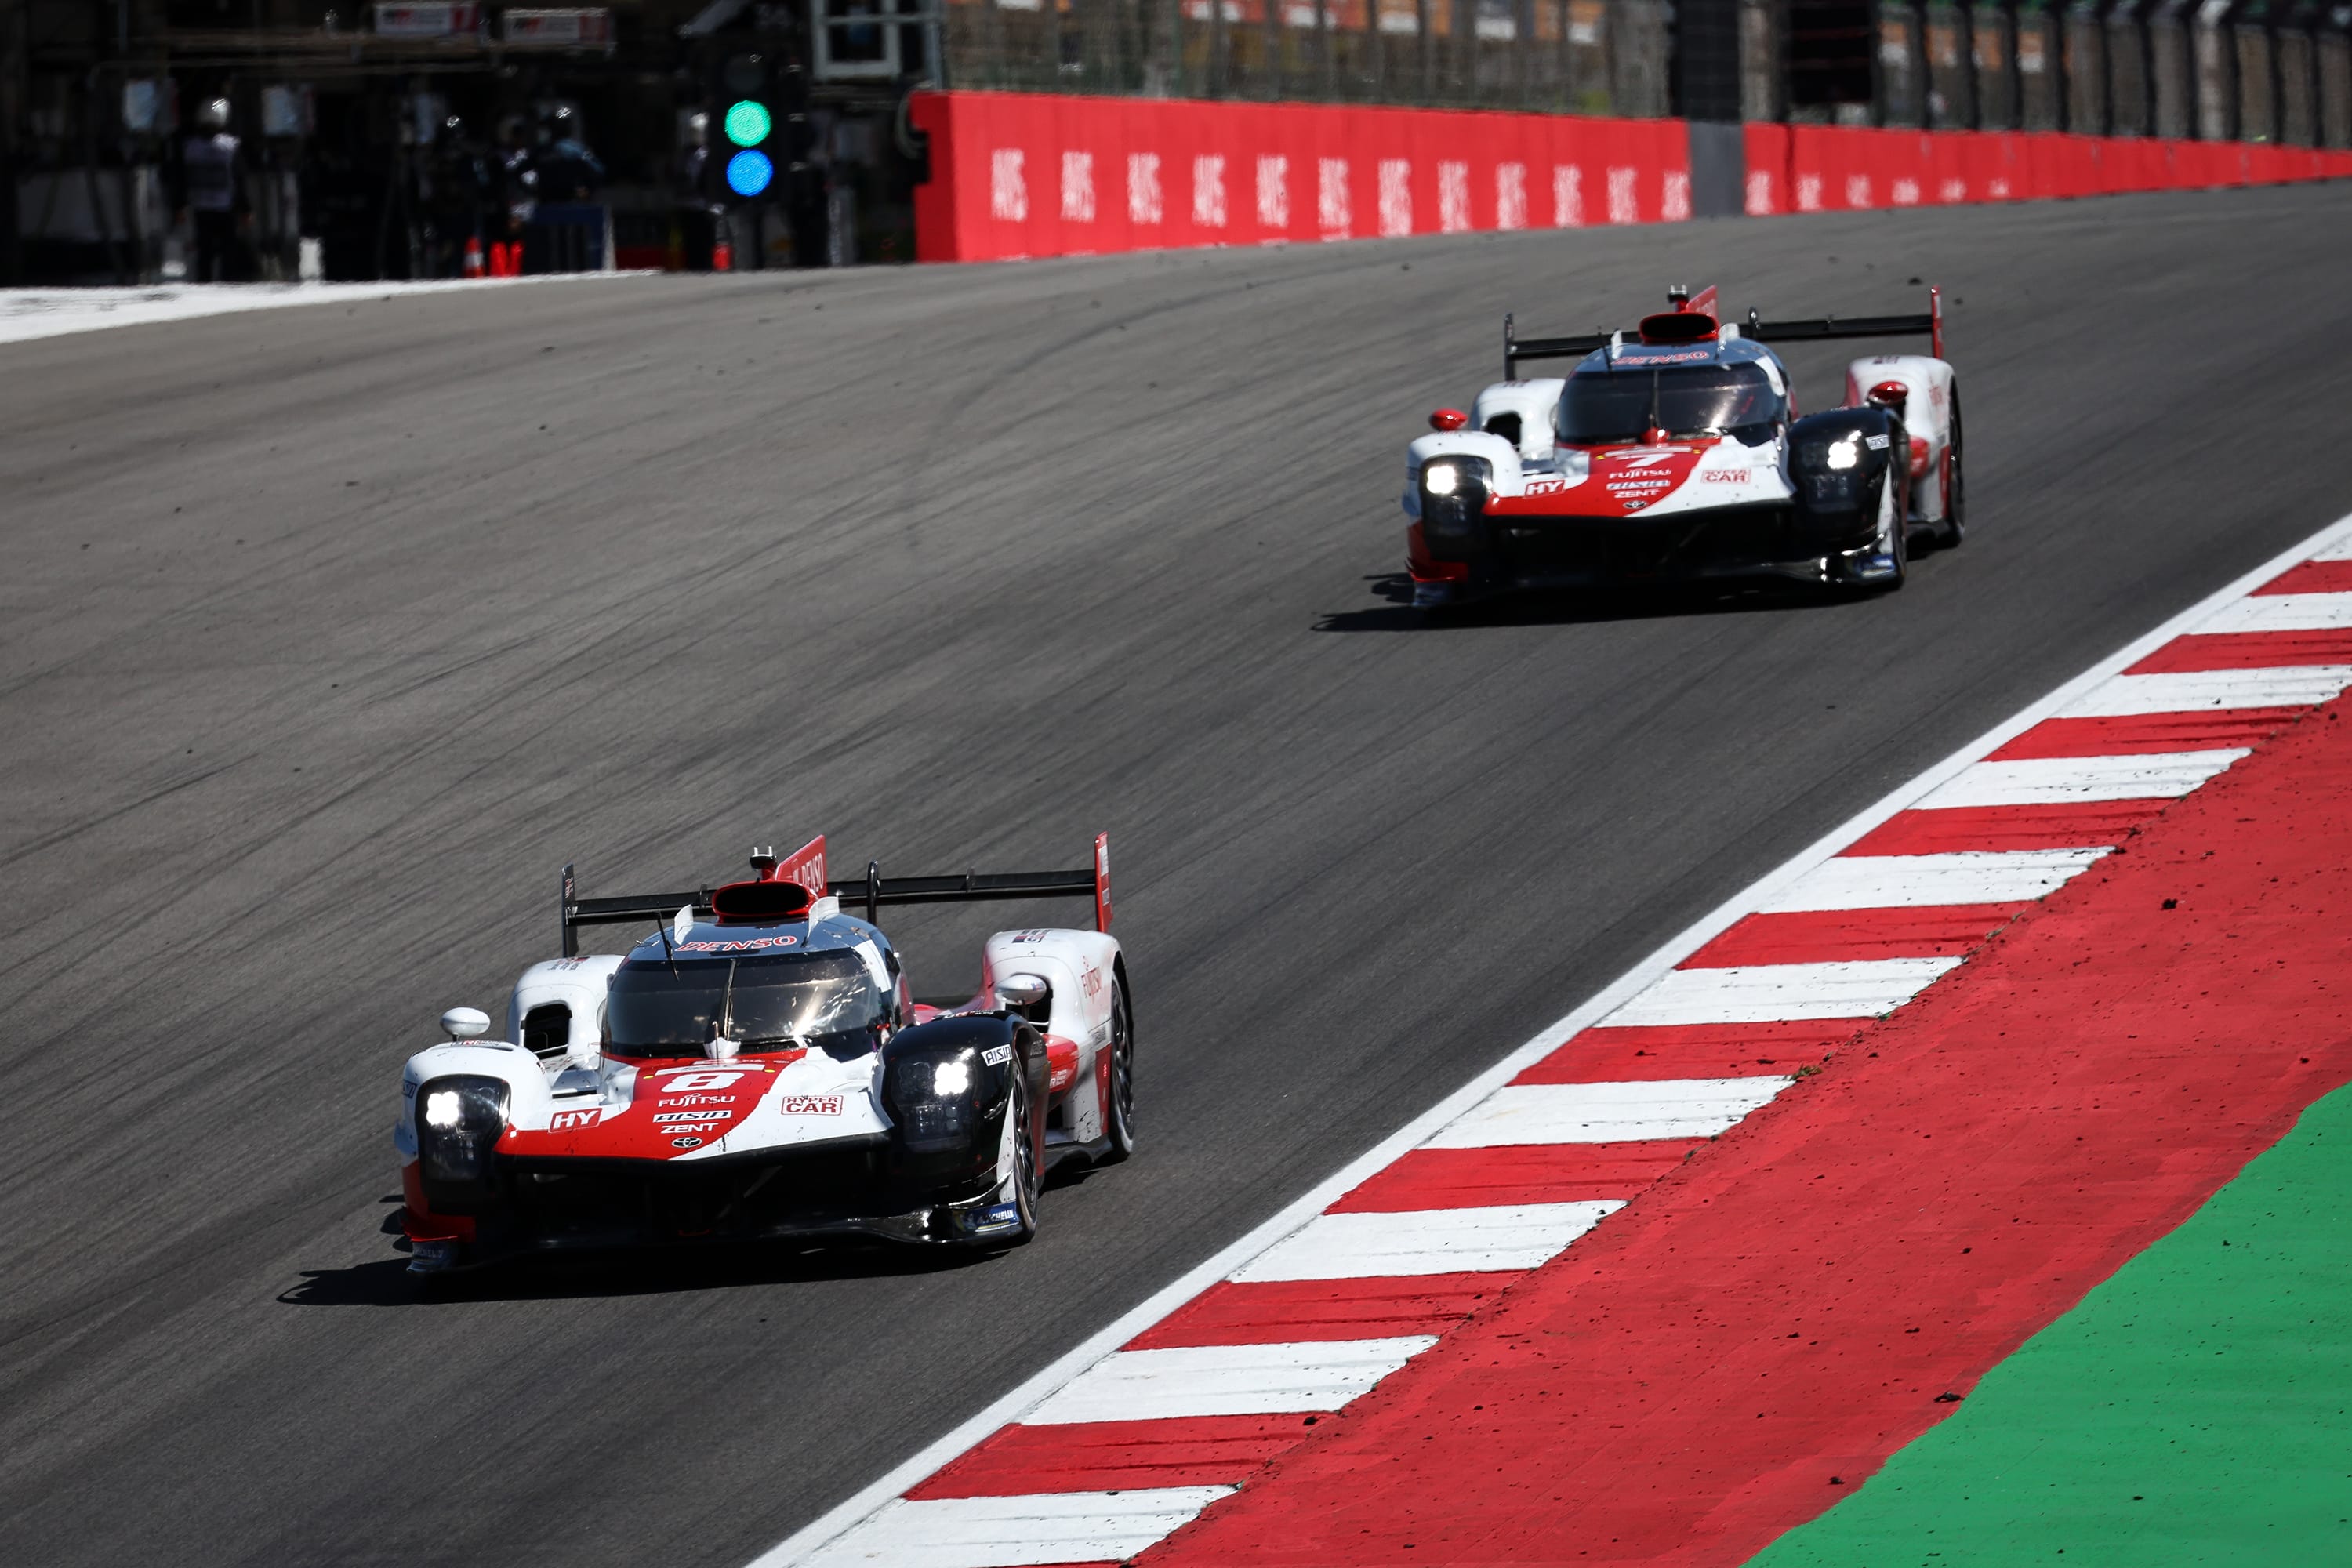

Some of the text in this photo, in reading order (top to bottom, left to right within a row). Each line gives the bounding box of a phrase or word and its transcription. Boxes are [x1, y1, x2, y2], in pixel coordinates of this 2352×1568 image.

[1610, 351, 1710, 365] DENSO
[1616, 453, 1675, 468] 7
[1609, 469, 1671, 479] FUJITSU
[1527, 481, 1564, 495] HY
[1614, 489, 1661, 499] ZENT
[675, 935, 798, 951] DENSO
[661, 1072, 745, 1092] 8
[658, 1094, 735, 1107] FUJITSU
[786, 1103, 837, 1113] CAR
[553, 1109, 599, 1129] HY
[660, 1123, 718, 1134] ZENT
